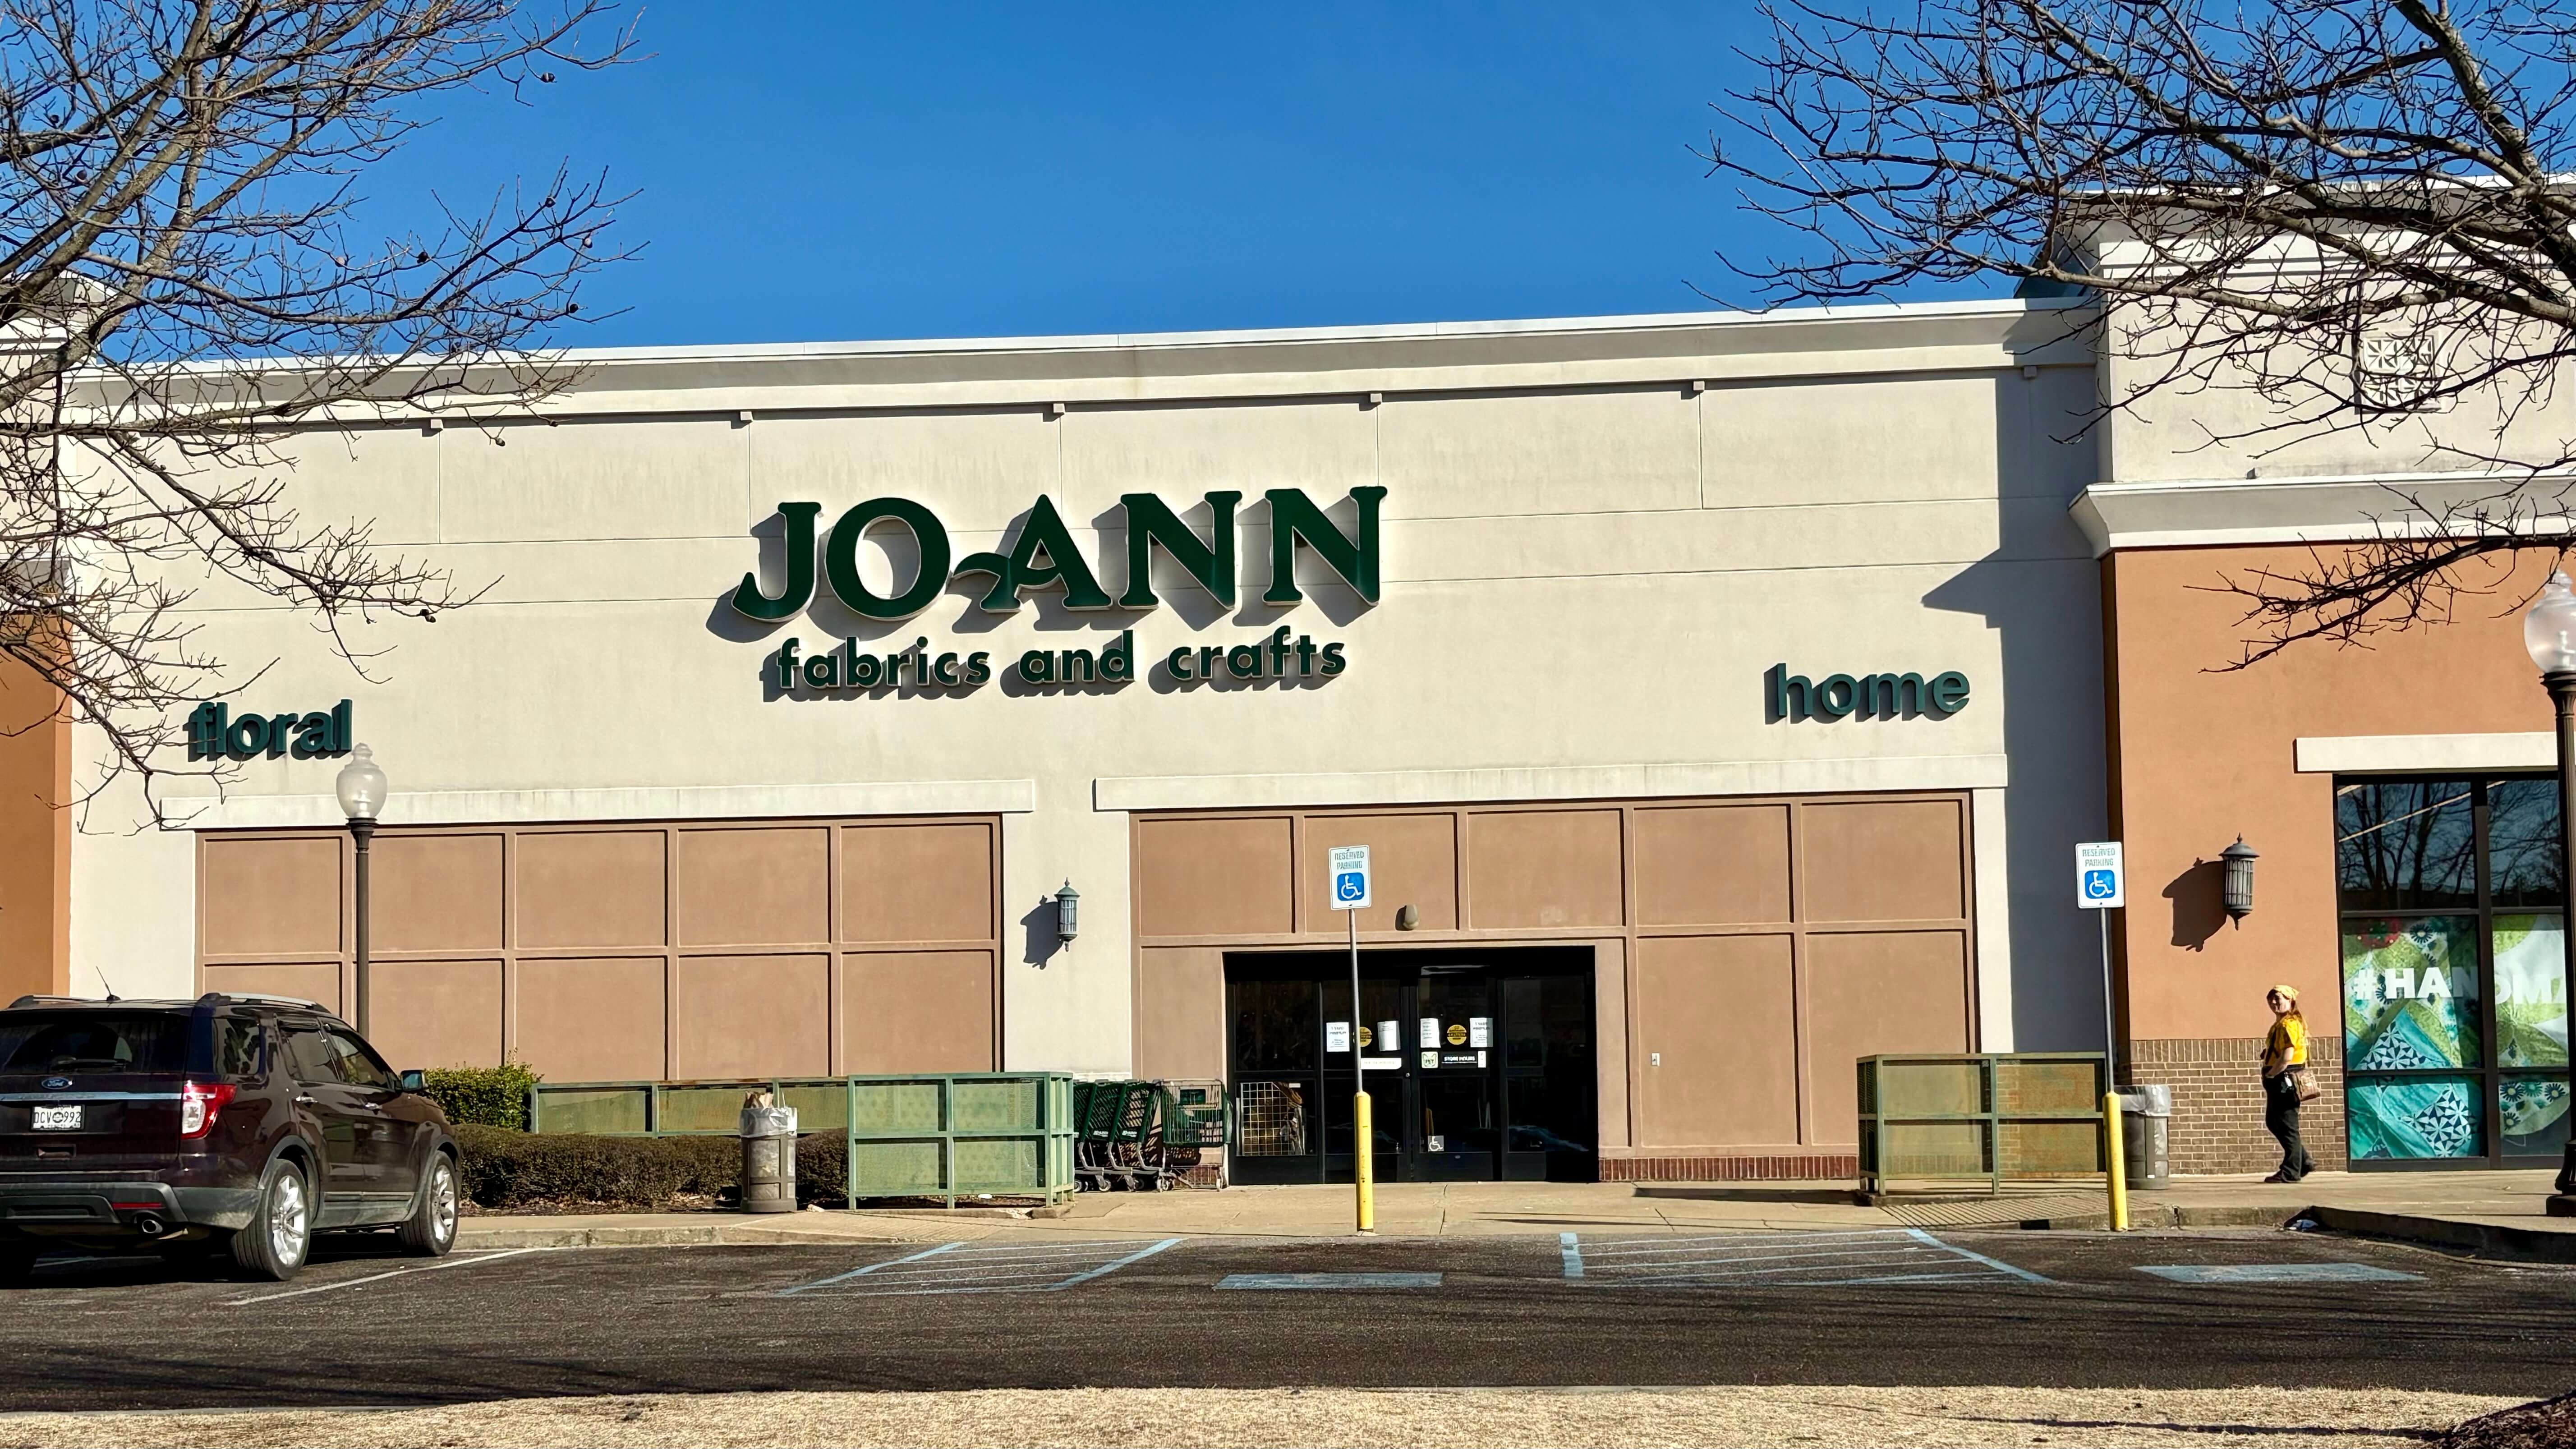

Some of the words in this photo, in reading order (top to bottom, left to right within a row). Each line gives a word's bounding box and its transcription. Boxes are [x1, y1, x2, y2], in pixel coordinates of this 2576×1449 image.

[731, 486, 1388, 622] JO-ANN
[777, 636, 990, 688] fabrics
[1018, 630, 1135, 683] and
[1167, 626, 1346, 681] crafts
[1776, 662, 1970, 716] home
[194, 699, 353, 754] floral
[1335, 851, 1364, 860] RESERVED
[1337, 861, 1362, 869] PARKING
[2082, 848, 2115, 857] RESERVED
[2085, 858, 2113, 867] PARKING
